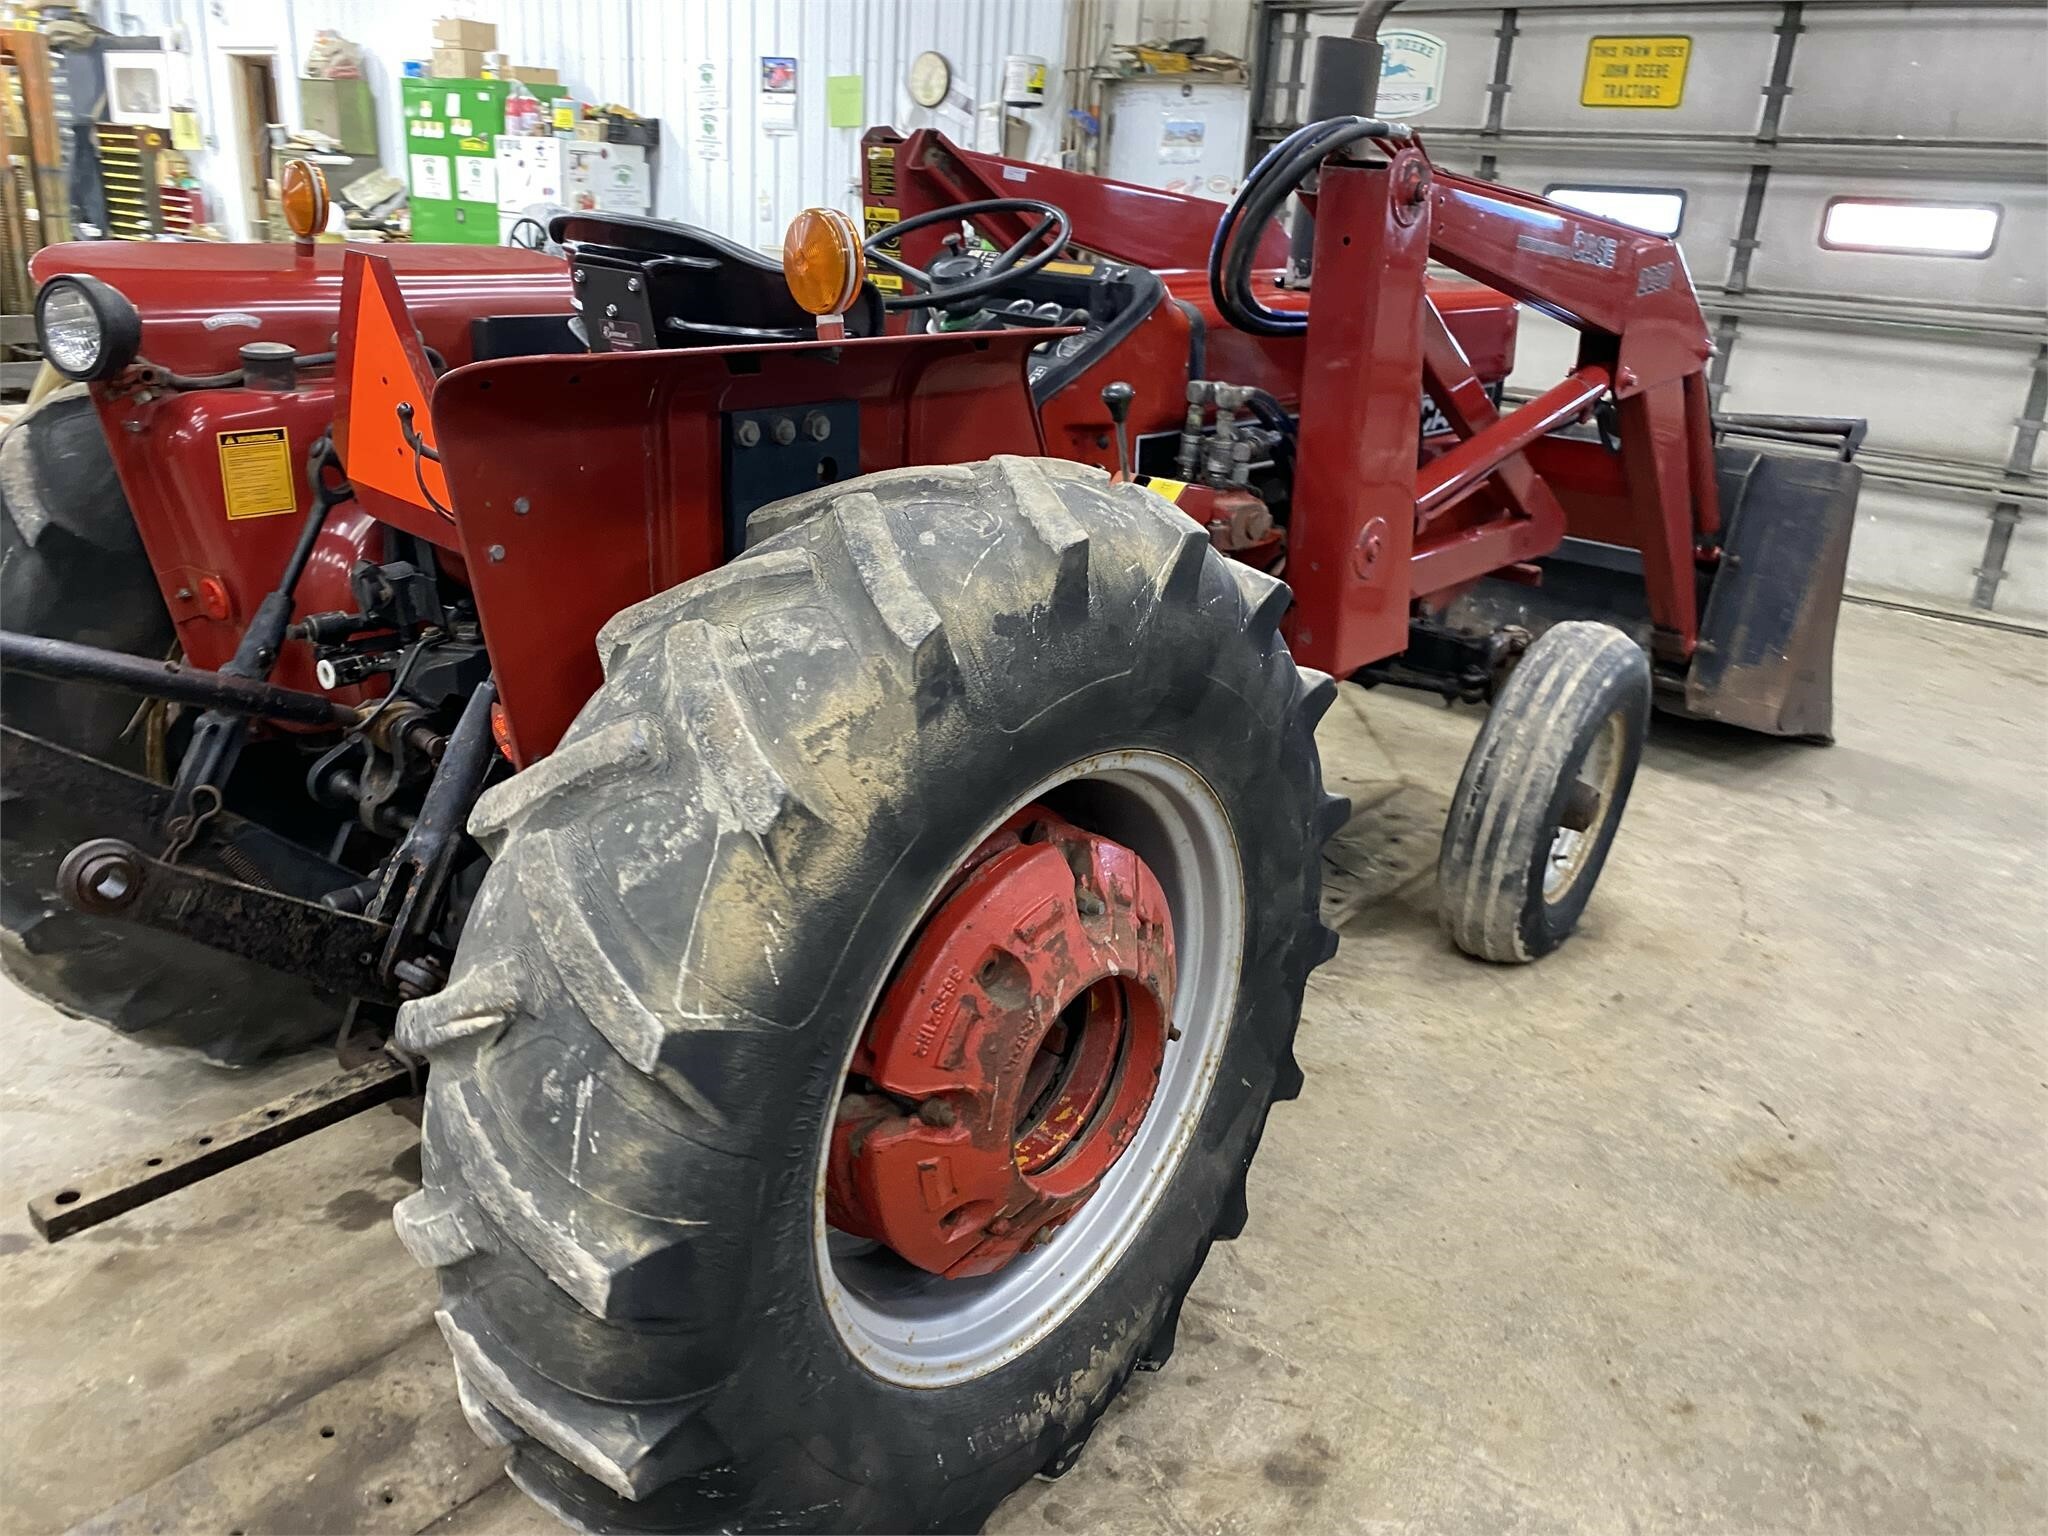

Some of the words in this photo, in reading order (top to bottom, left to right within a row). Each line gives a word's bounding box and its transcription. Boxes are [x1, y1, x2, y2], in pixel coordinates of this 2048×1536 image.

[1593, 46, 1618, 57] THIS
[1622, 45, 1652, 57] FARM
[1656, 46, 1686, 58] USES
[1601, 63, 1629, 78] JOHN
[1634, 63, 1671, 78] DEERE
[1603, 84, 1662, 99] TRACTORS
[1572, 230, 1618, 269] CASE
